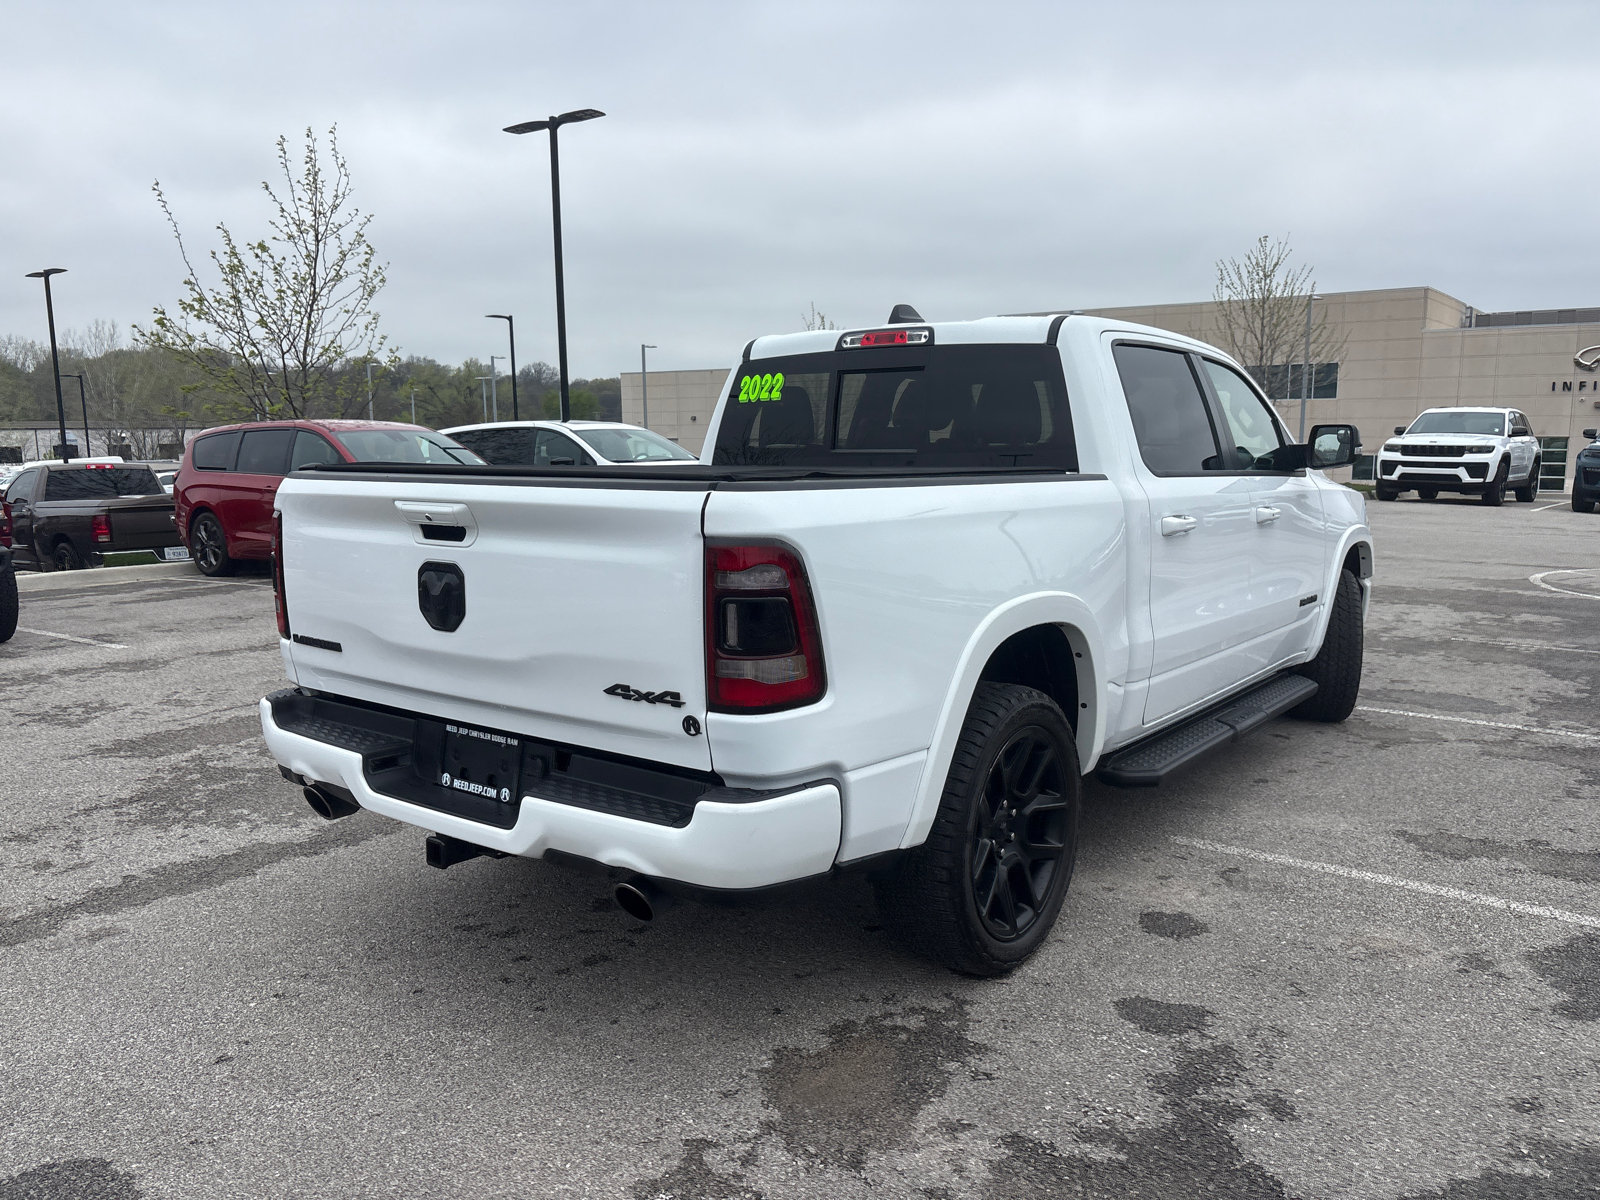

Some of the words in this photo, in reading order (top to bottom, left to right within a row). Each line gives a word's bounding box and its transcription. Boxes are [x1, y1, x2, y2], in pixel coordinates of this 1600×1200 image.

[739, 373, 784, 403] 2022
[1552, 381, 1597, 391] INFI
[446, 724, 457, 733] REED
[458, 727, 468, 735] JEEP
[469, 730, 491, 740] CHRYSLER
[491, 734, 506, 744] DODGE
[507, 737, 518, 746] RAM
[453, 778, 497, 798] REEDJEEP.COM
